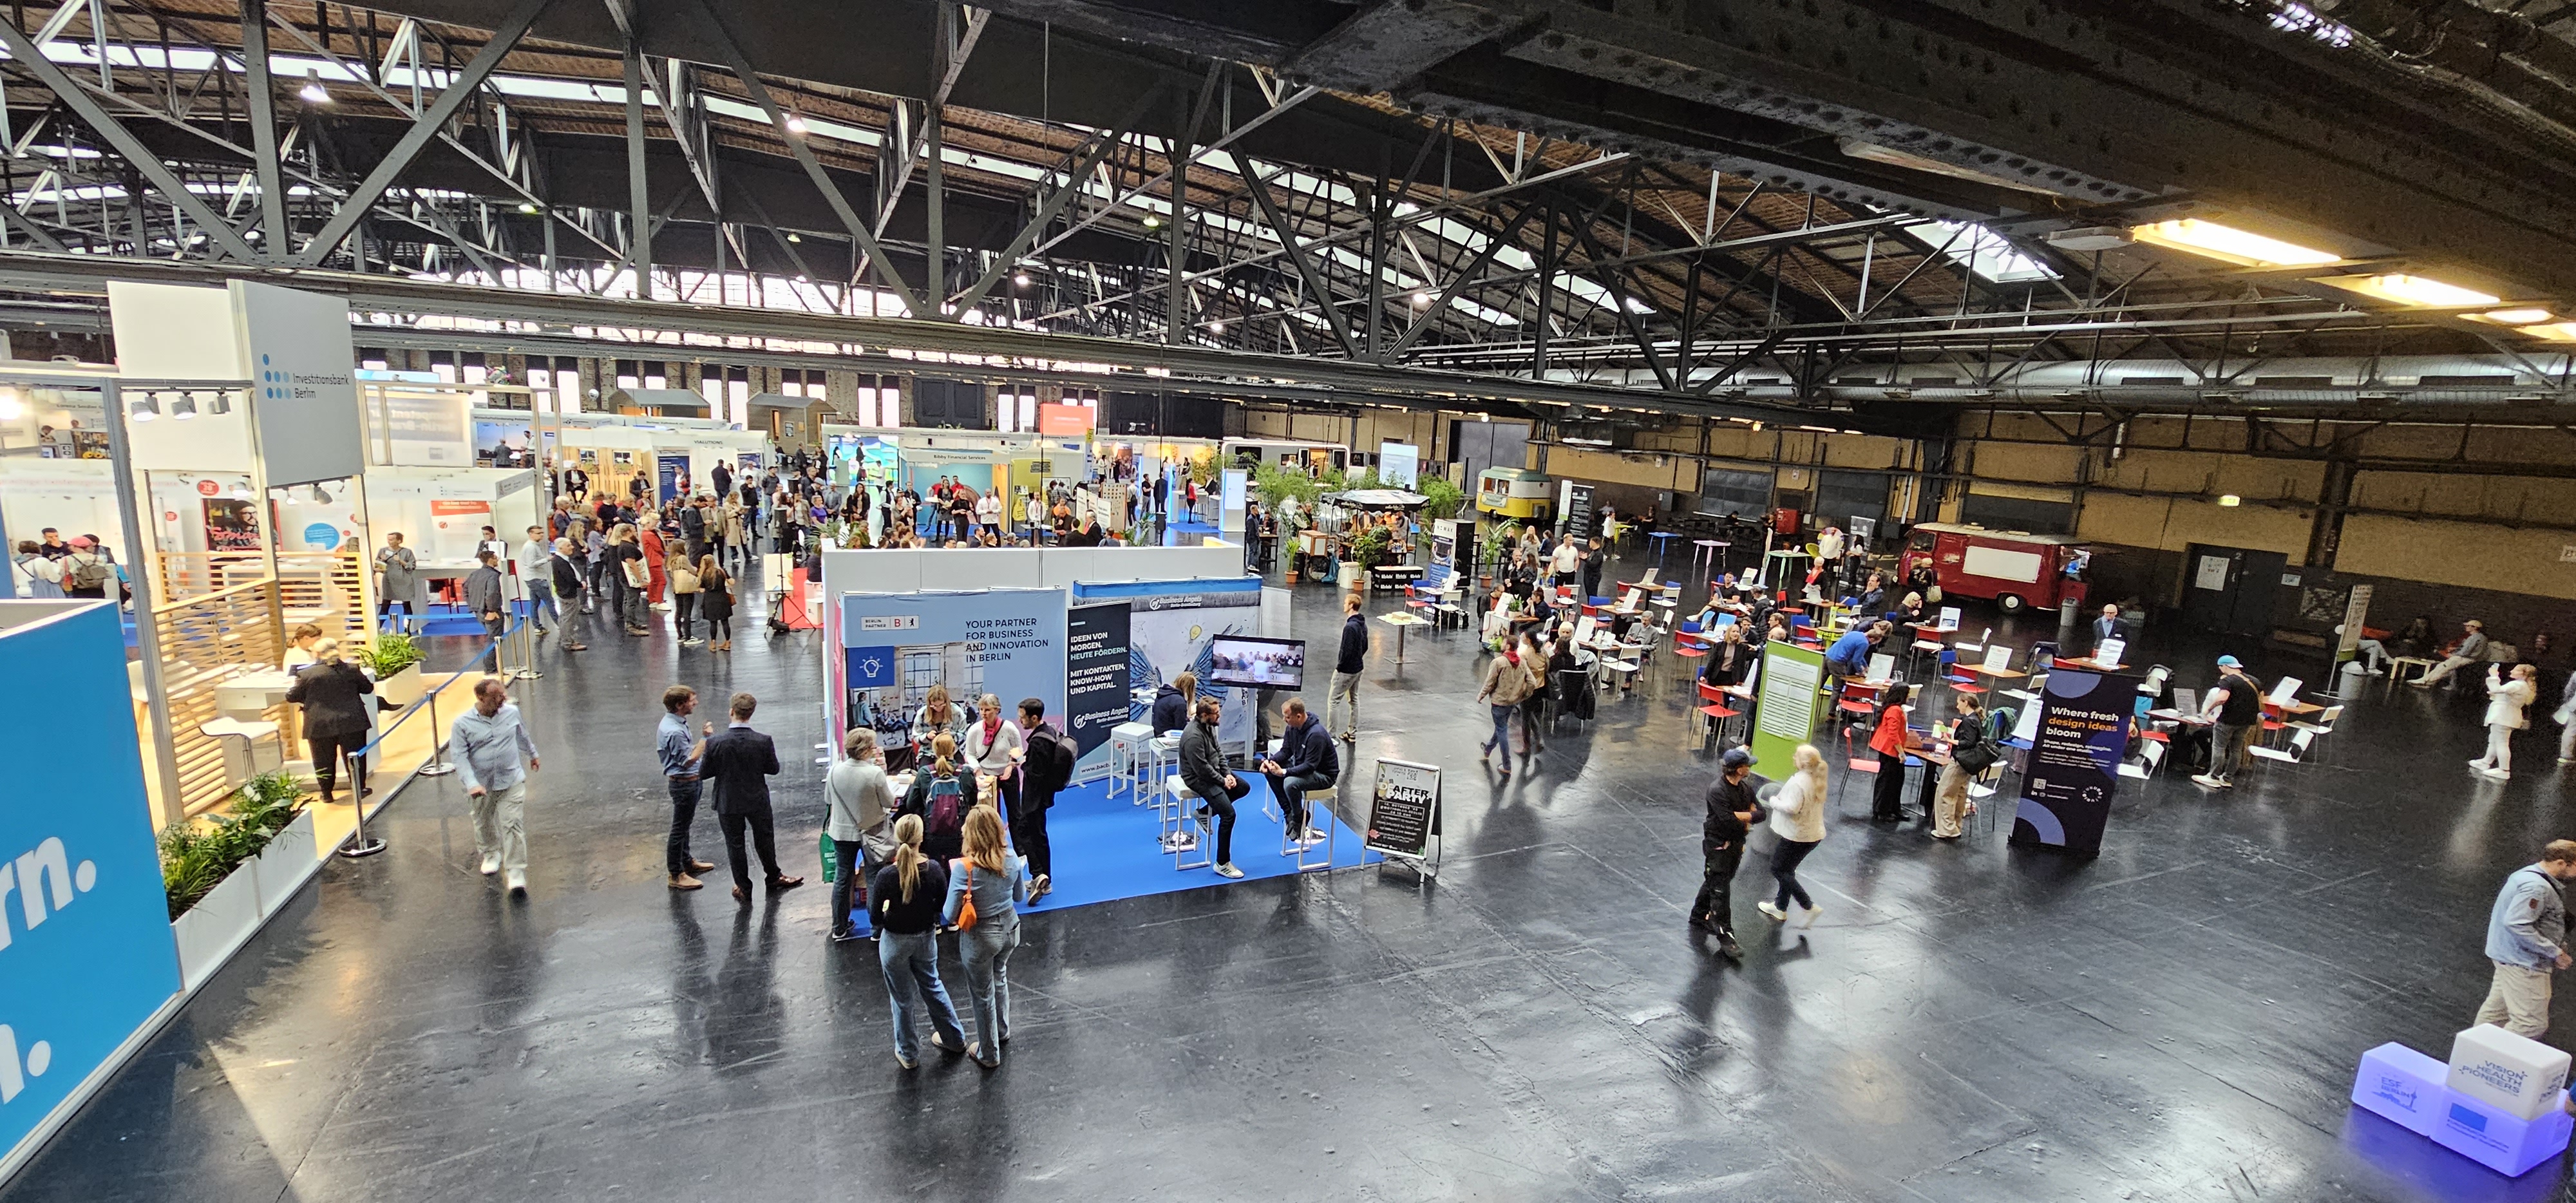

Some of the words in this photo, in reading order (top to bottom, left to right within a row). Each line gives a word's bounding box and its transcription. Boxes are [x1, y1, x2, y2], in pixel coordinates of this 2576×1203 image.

[292, 373, 350, 386] Investitionsbank
[294, 387, 317, 399] Berlin
[995, 618, 1037, 627] PARTNER
[989, 629, 1034, 639] BUSINESS
[1070, 634, 1092, 643] IDEEN
[966, 643, 987, 652] AND
[989, 639, 1048, 650] INNOVATION
[1070, 641, 1103, 652] MORGEN.
[979, 653, 1011, 662] BERLIN
[1070, 652, 1093, 661] HEUTE
[1094, 646, 1127, 658] FÖRDERN.
[1070, 669, 1083, 677] MIT
[1084, 663, 1126, 676] KONTAKTEN,
[1070, 674, 1113, 687] KNOW-HOW
[1070, 687, 1086, 695] UND
[1087, 681, 1117, 692] KAPITAL.
[1084, 711, 1110, 721] Business
[1111, 706, 1129, 716] Angels
[2051, 706, 2088, 718] Where
[2090, 710, 2119, 721] fresh
[2048, 717, 2086, 728] design
[2088, 721, 2117, 732] ideas
[2046, 726, 2081, 738] bloom
[1081, 761, 1117, 773] www.bacb.e
[1386, 790, 1427, 804] PARTY
[2476, 1064, 2523, 1087] HEALTH
[2485, 1060, 2523, 1079] VISION
[2381, 1076, 2403, 1089] ESF
[2462, 1065, 2520, 1094] PIONEERS
[2380, 1084, 2410, 1098] BERLIN
